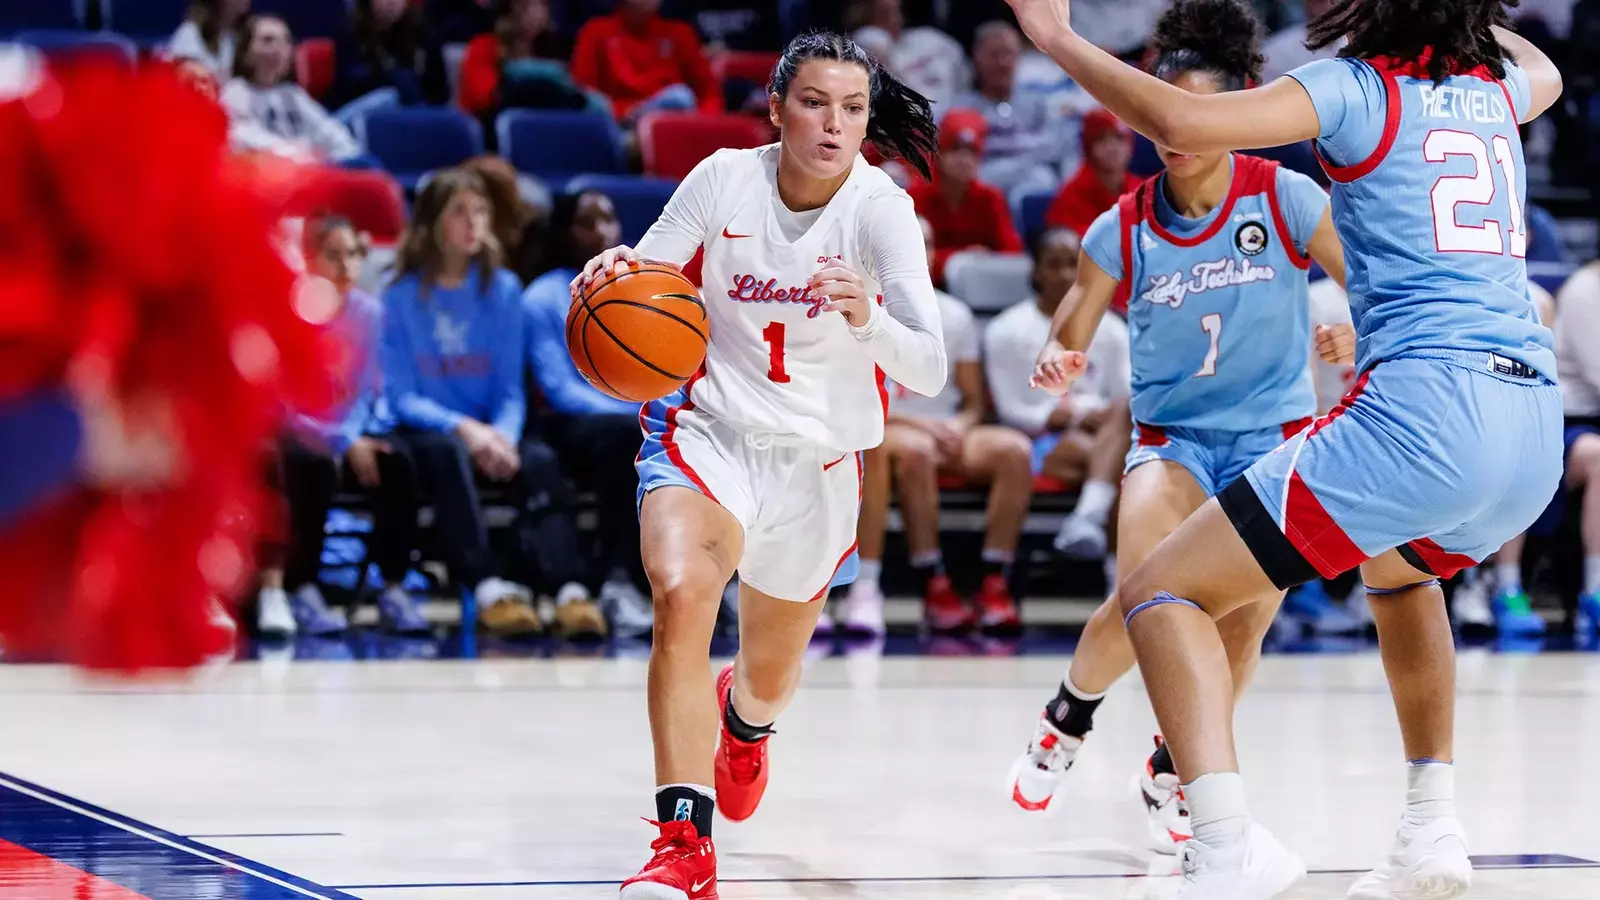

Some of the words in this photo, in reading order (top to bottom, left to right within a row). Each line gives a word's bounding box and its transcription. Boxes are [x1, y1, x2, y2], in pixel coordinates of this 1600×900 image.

[1418, 85, 1505, 124] RIETVELD
[1423, 129, 1526, 259] 21
[727, 274, 828, 319] Liberty
[1141, 270, 1189, 309] Lady
[1187, 256, 1276, 293] Techsters
[762, 321, 791, 383] 1
[1192, 313, 1222, 378] 1
